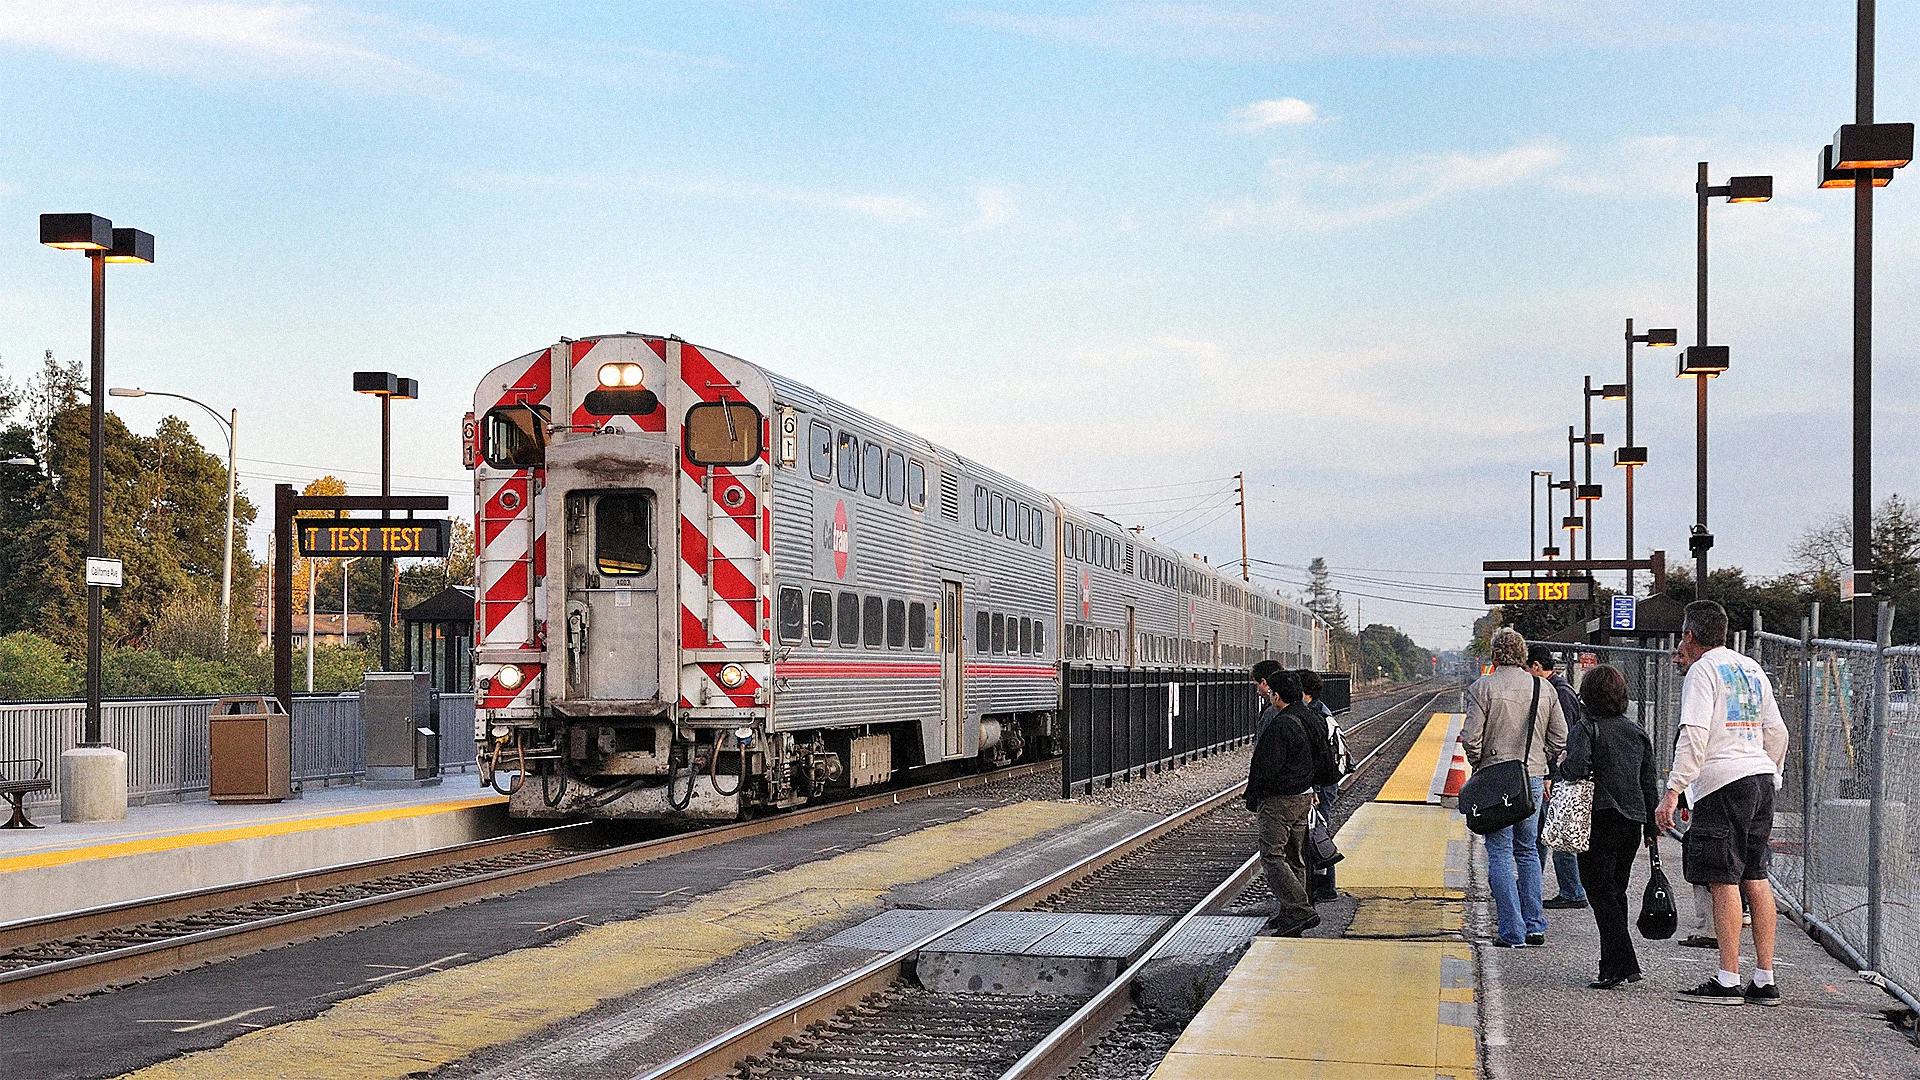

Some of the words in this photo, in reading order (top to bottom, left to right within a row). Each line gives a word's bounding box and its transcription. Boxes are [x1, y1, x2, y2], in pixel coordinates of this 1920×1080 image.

[328, 527, 371, 551] TEST
[380, 527, 423, 551] TEST
[1497, 582, 1531, 600] TEST
[1536, 582, 1571, 600] TEST
